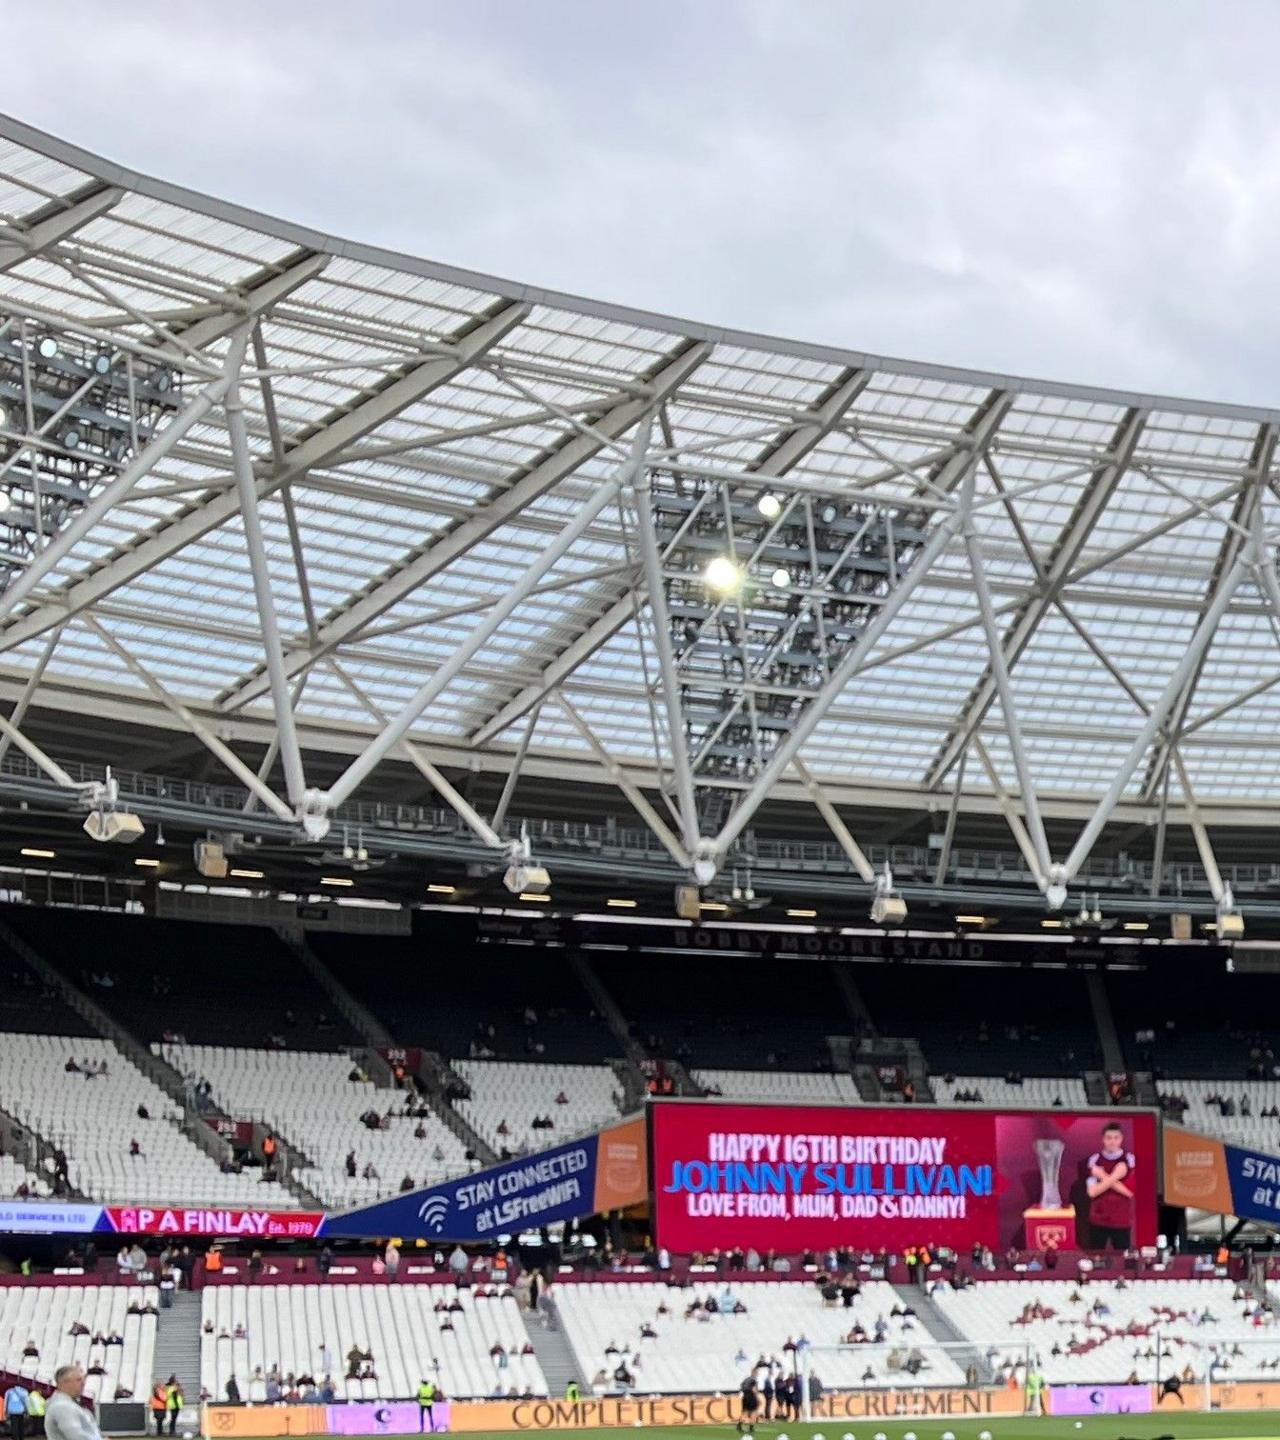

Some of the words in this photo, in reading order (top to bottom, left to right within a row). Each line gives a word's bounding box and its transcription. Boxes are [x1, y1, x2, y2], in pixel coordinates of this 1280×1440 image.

[674, 930, 770, 949] BOBBY
[782, 934, 883, 954] MOORE
[892, 937, 985, 958] STAND
[709, 1132, 781, 1162] HAPPY
[784, 1134, 837, 1163] 16TH
[841, 1136, 946, 1164] BIRTHDAY
[455, 1178, 495, 1210] STAY
[498, 1149, 587, 1197] CONNECTED
[664, 1160, 807, 1194] JOHNNY
[813, 1163, 992, 1196] SULLIVAN!
[688, 1194, 735, 1217] LOVE
[738, 1194, 791, 1221] FROM,
[793, 1195, 838, 1221] MUM,
[841, 1196, 877, 1218] DAD
[880, 1195, 899, 1219] &
[901, 1195, 965, 1219] DANNY!
[1253, 1186, 1274, 1207] at
[139, 1210, 154, 1231] P
[159, 1210, 179, 1232] A
[184, 1211, 269, 1234] FINLAY
[476, 1206, 494, 1232] at
[512, 1398, 665, 1428] COMPLETE
[811, 1391, 995, 1418] RECRUITMENT
